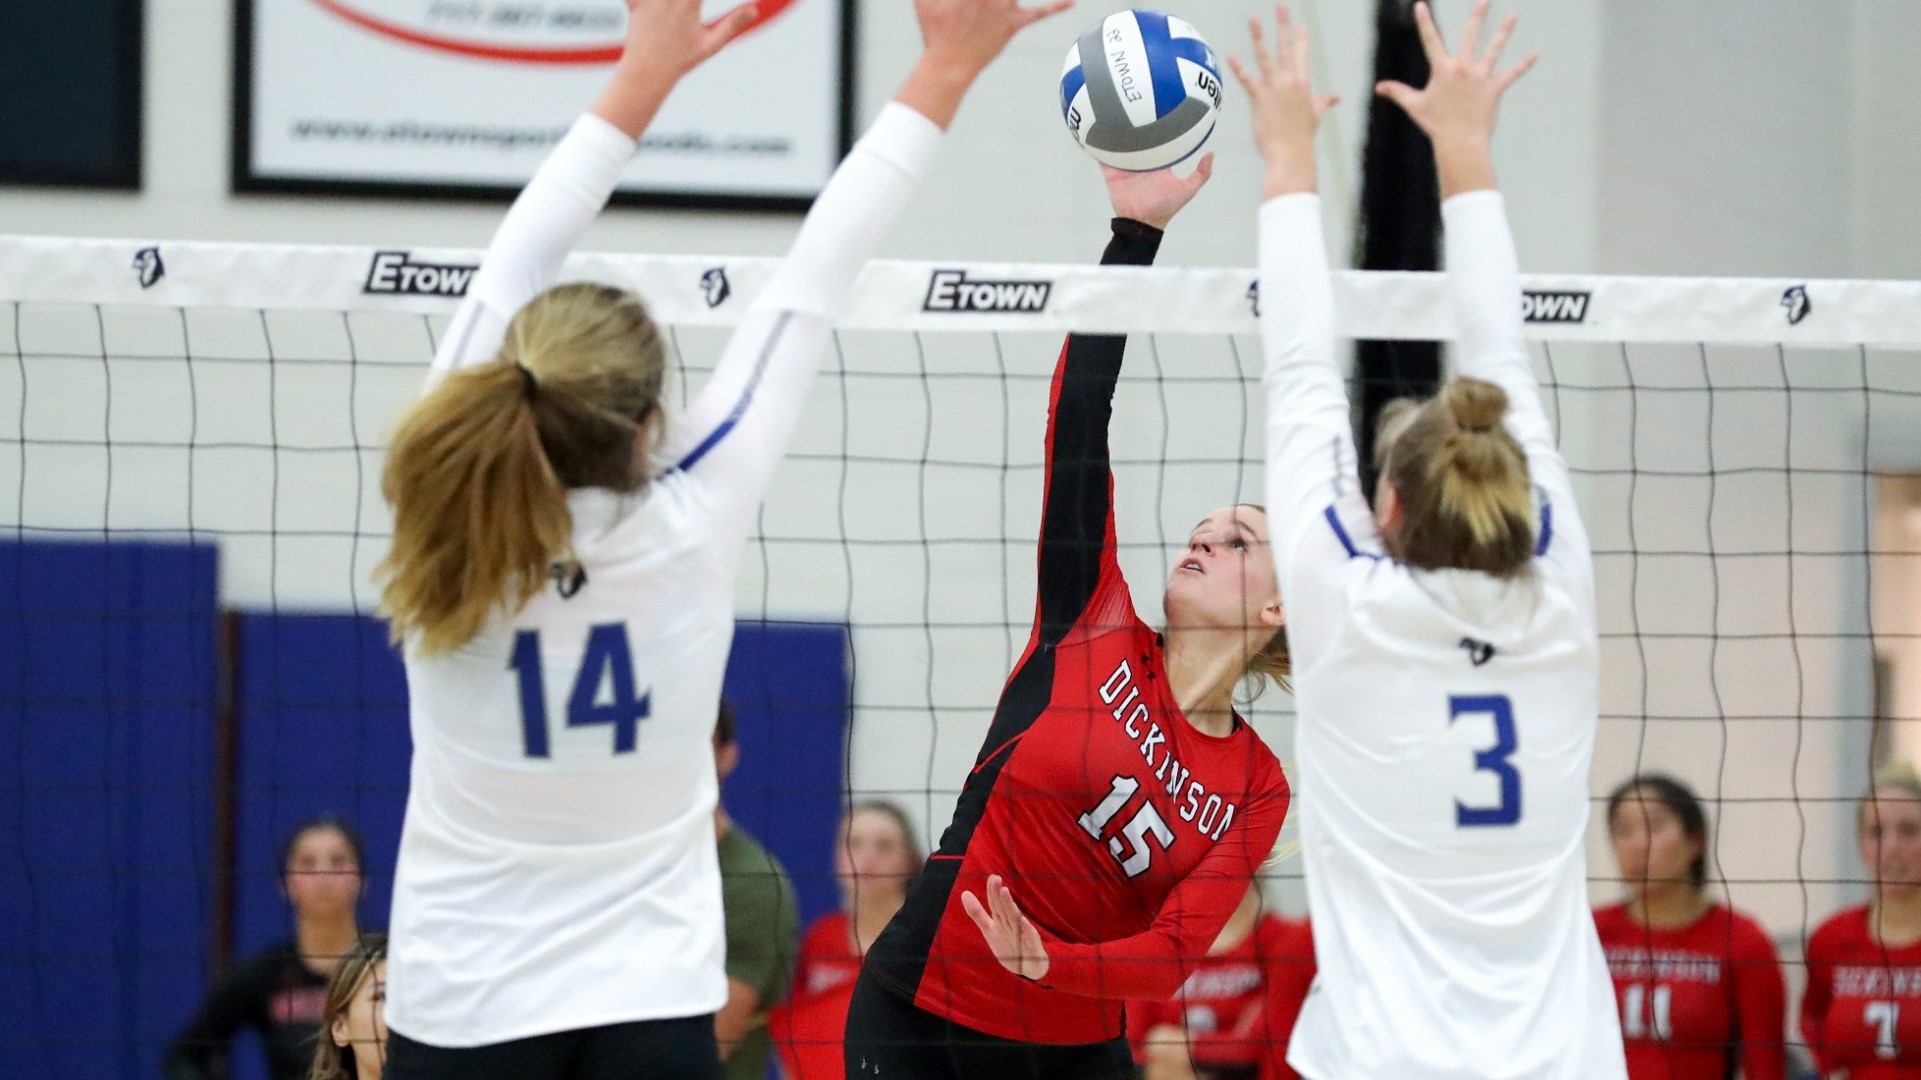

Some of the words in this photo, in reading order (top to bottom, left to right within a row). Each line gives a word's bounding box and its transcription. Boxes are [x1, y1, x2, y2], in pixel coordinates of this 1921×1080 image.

[1110, 50, 1142, 103] ETOWN
[365, 252, 476, 296] ETOW
[925, 270, 1051, 311] ETOWN
[1521, 292, 1589, 322] OWN
[505, 620, 651, 759] 14
[1098, 658, 1236, 842] DICKINSON
[1447, 693, 1523, 827] 3
[1077, 774, 1176, 879] 15
[1624, 983, 1673, 1040] 11
[1863, 1001, 1900, 1061] 7
